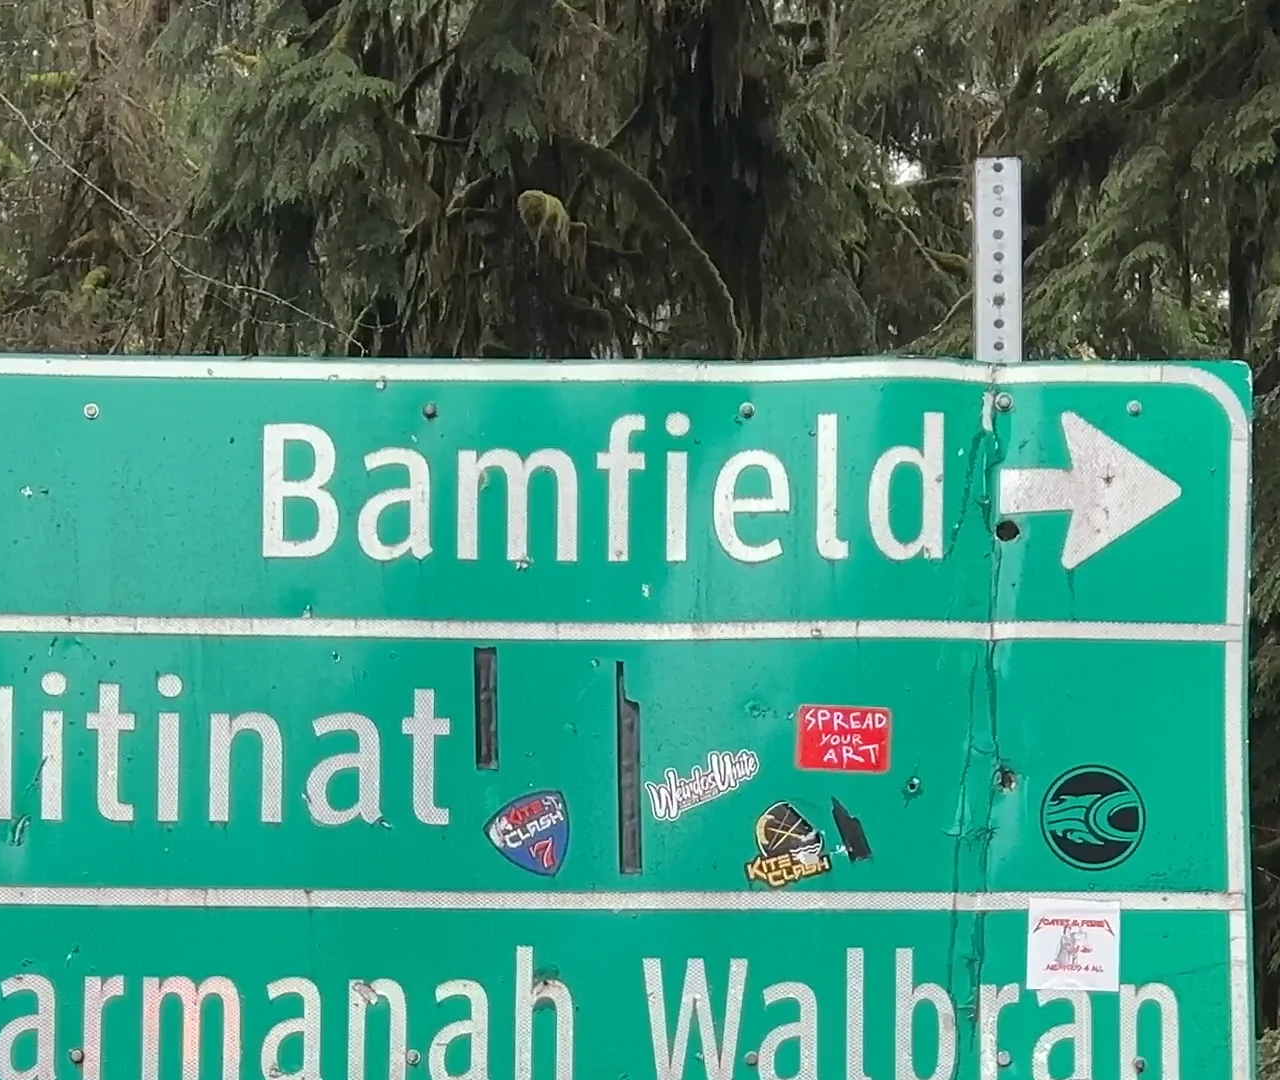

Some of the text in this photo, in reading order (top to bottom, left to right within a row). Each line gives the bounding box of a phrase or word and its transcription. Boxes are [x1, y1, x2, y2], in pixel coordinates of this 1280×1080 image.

[263, 413, 944, 563] Bamfield
[805, 708, 887, 731] SPREAD
[819, 733, 864, 746] YOUR
[823, 744, 880, 769] ART
[646, 769, 718, 818] Weirdos
[710, 752, 757, 790] Unite
[504, 810, 565, 848] CLASH
[529, 836, 555, 870] 7
[747, 854, 792, 880] KITE
[768, 857, 830, 886] CLASH
